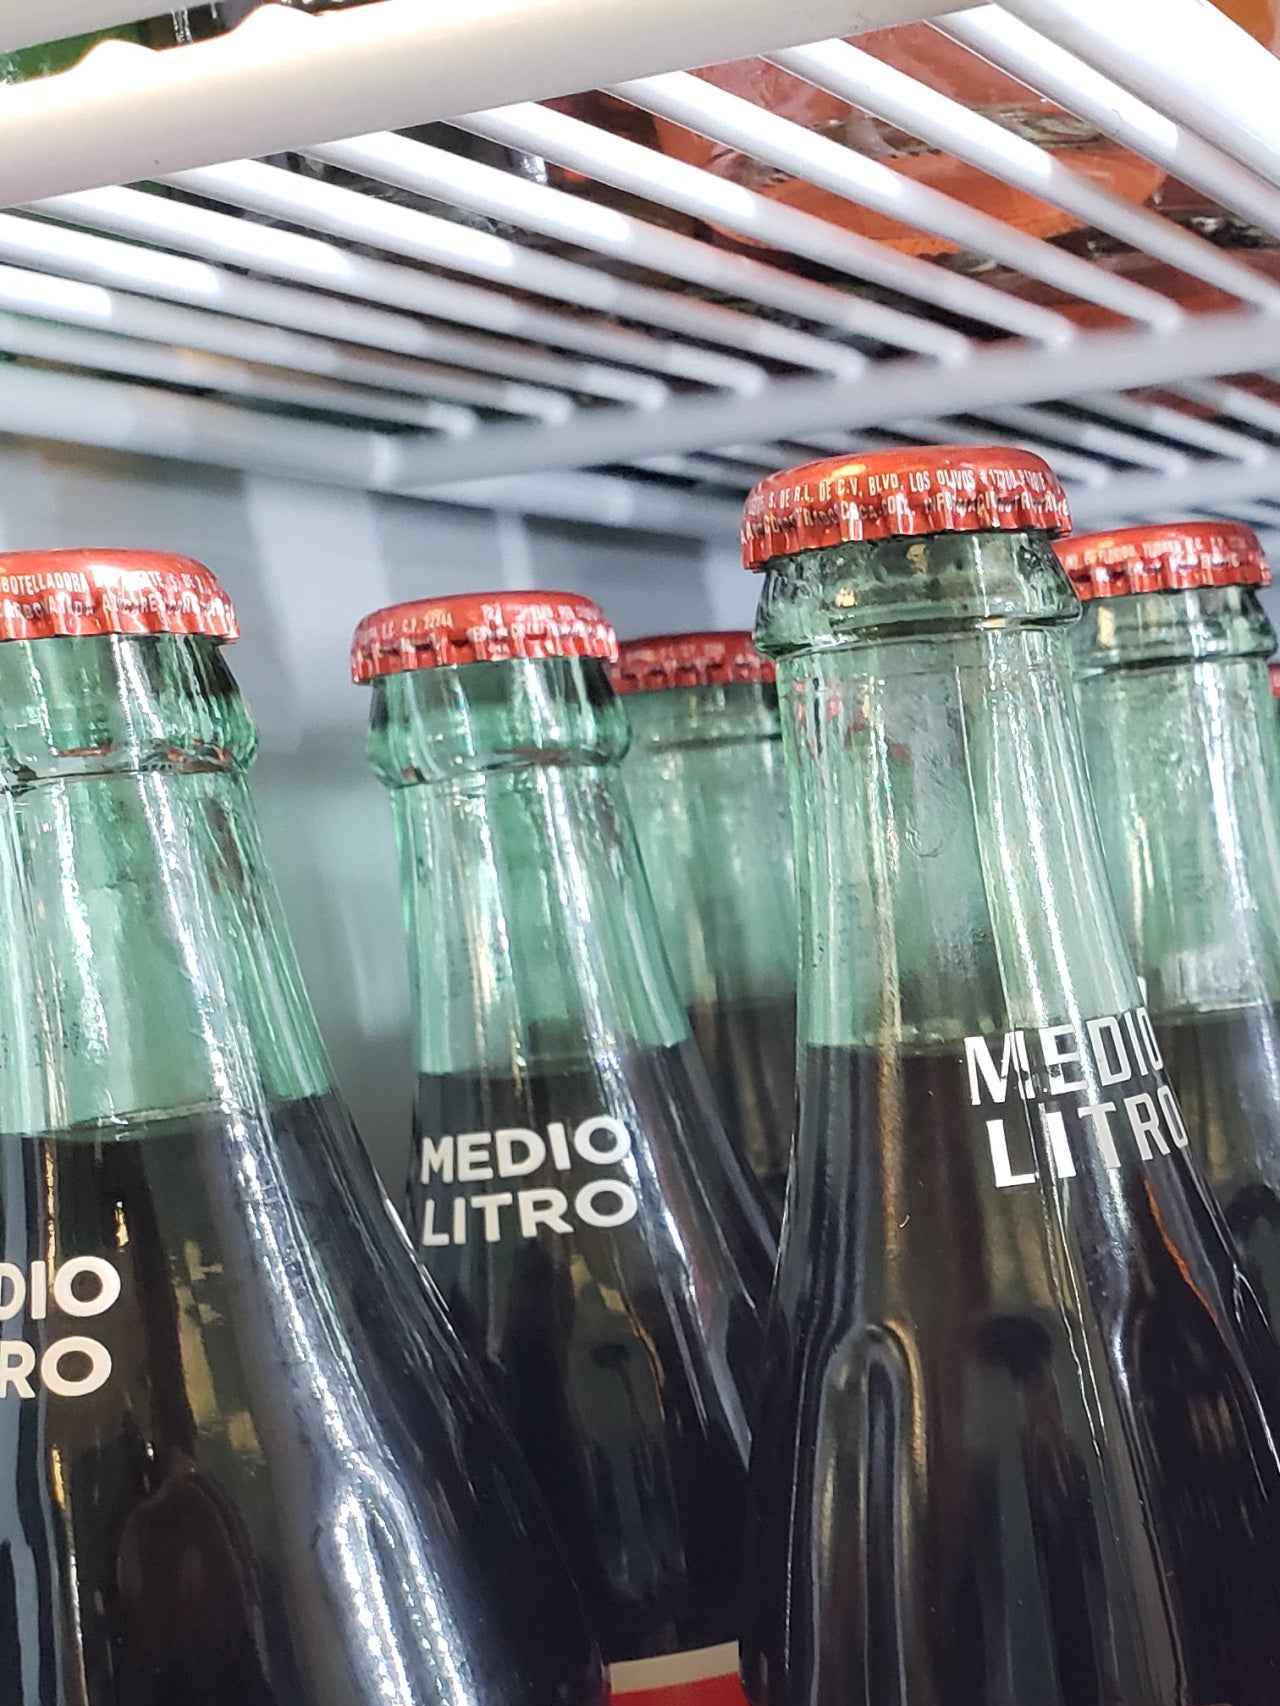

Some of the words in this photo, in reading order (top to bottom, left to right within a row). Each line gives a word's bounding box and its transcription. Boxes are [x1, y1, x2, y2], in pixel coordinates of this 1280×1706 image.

[868, 472, 904, 496] BLVD.
[909, 470, 931, 493] LOS
[1, 571, 91, 596] BOTELLADORA
[421, 1116, 631, 1184] MEDIO
[986, 1085, 1188, 1188] LITRO
[421, 1178, 639, 1247] LITRO
